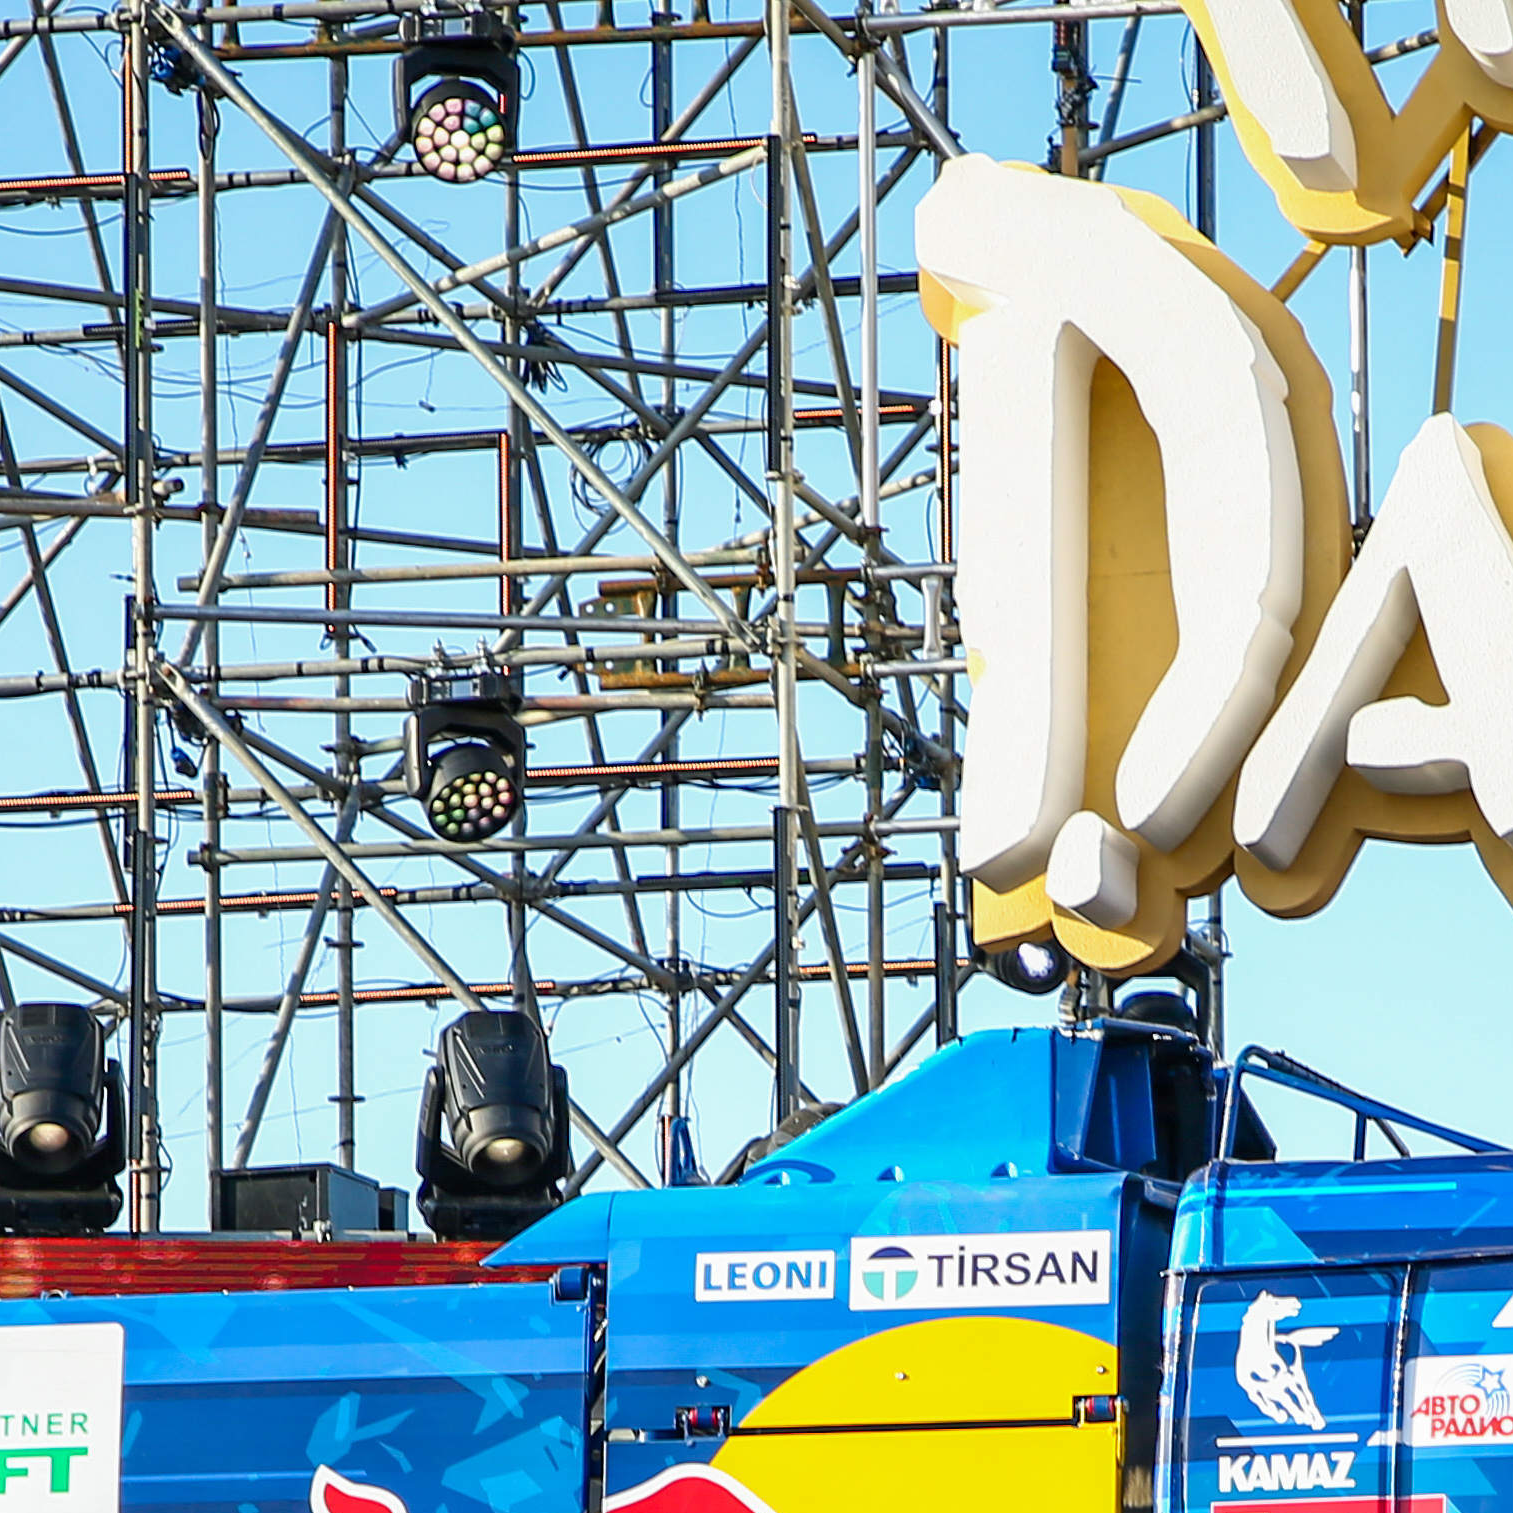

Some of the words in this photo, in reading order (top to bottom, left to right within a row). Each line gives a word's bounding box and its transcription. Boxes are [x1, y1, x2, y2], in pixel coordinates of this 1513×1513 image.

[702, 1260, 828, 1292] LEONI
[1411, 1393, 1482, 1419] АВТО
[1217, 1450, 1357, 1493] KAMAZ
